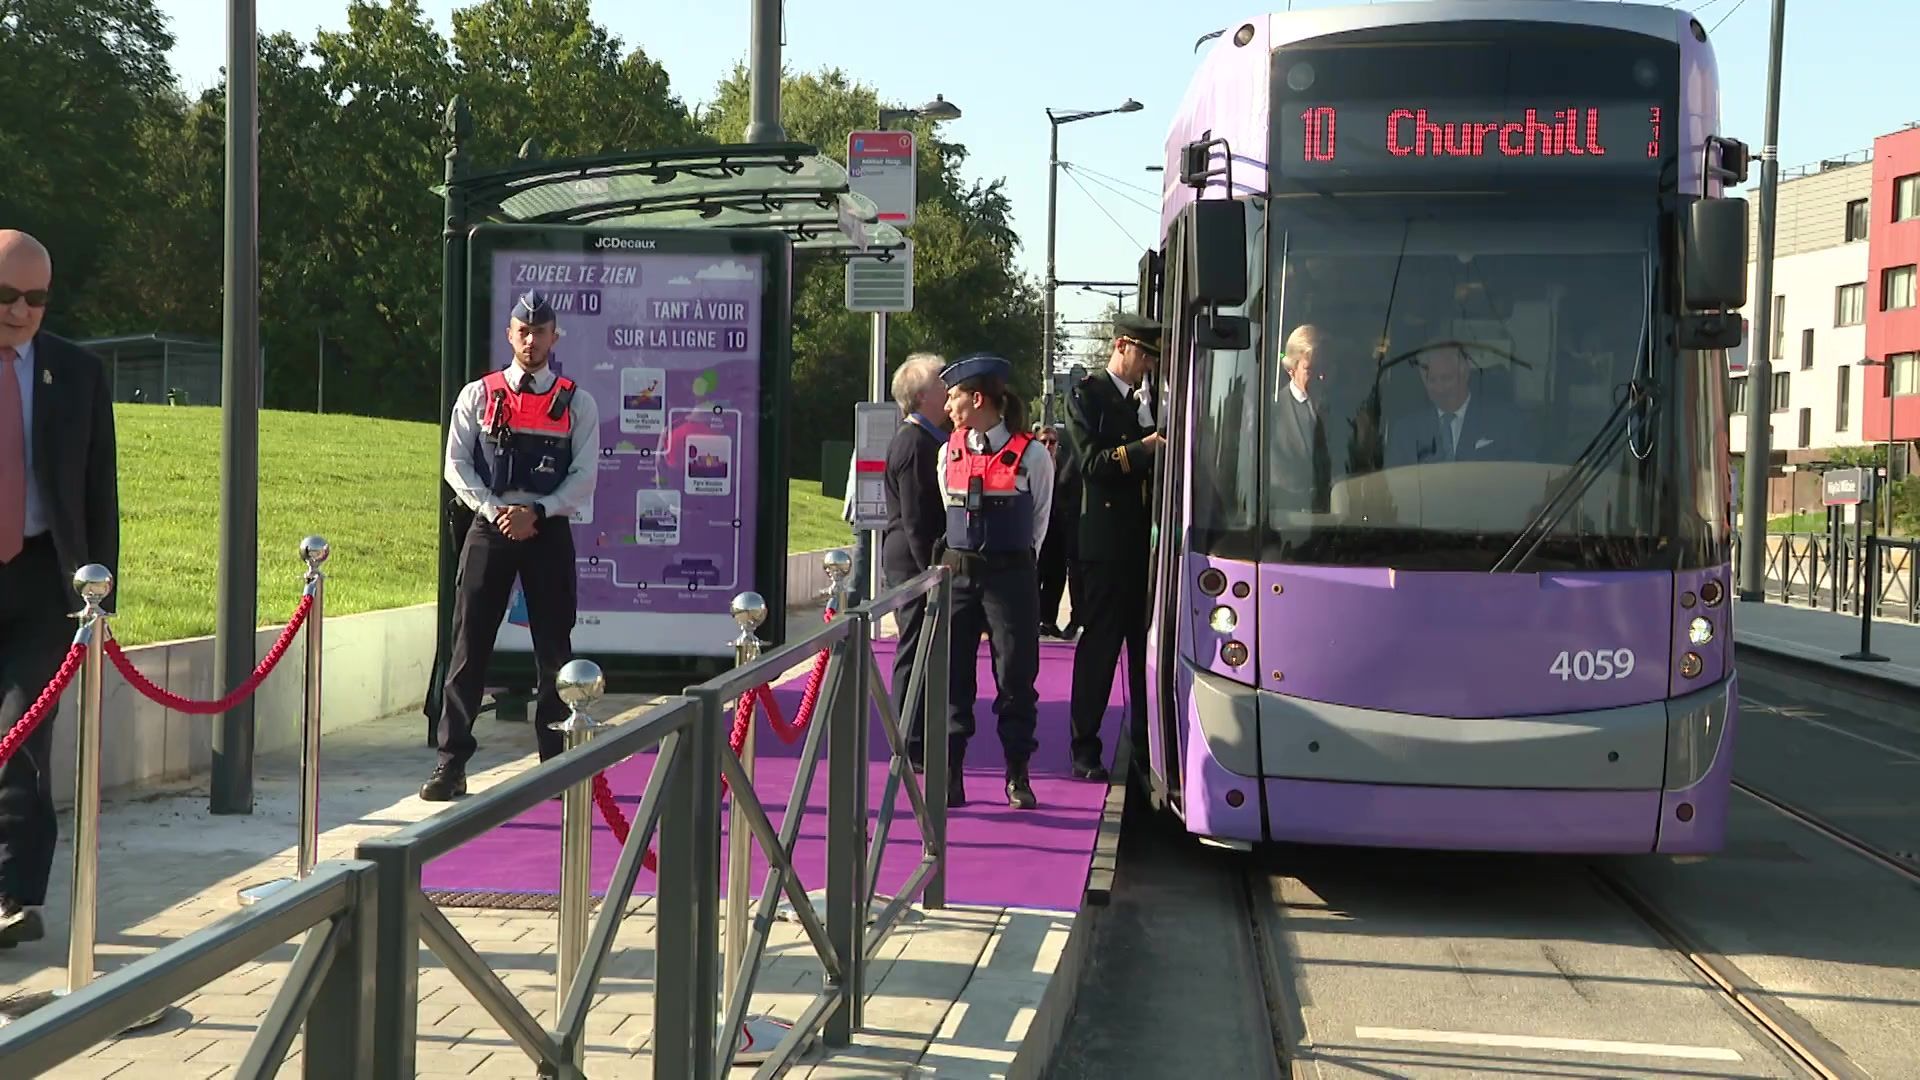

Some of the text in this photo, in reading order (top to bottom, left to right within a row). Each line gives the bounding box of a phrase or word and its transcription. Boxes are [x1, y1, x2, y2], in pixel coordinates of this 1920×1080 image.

[1300, 107, 1605, 161] 10 Churchill
[595, 237, 656, 249] JCDecaux
[516, 264, 637, 284] ZOVEEL TE ZIEN
[580, 293, 599, 311] 10
[653, 299, 745, 320] TANT À VOIR
[614, 329, 745, 348] SUR LA LIGNE 10
[1549, 648, 1635, 680] 4059
